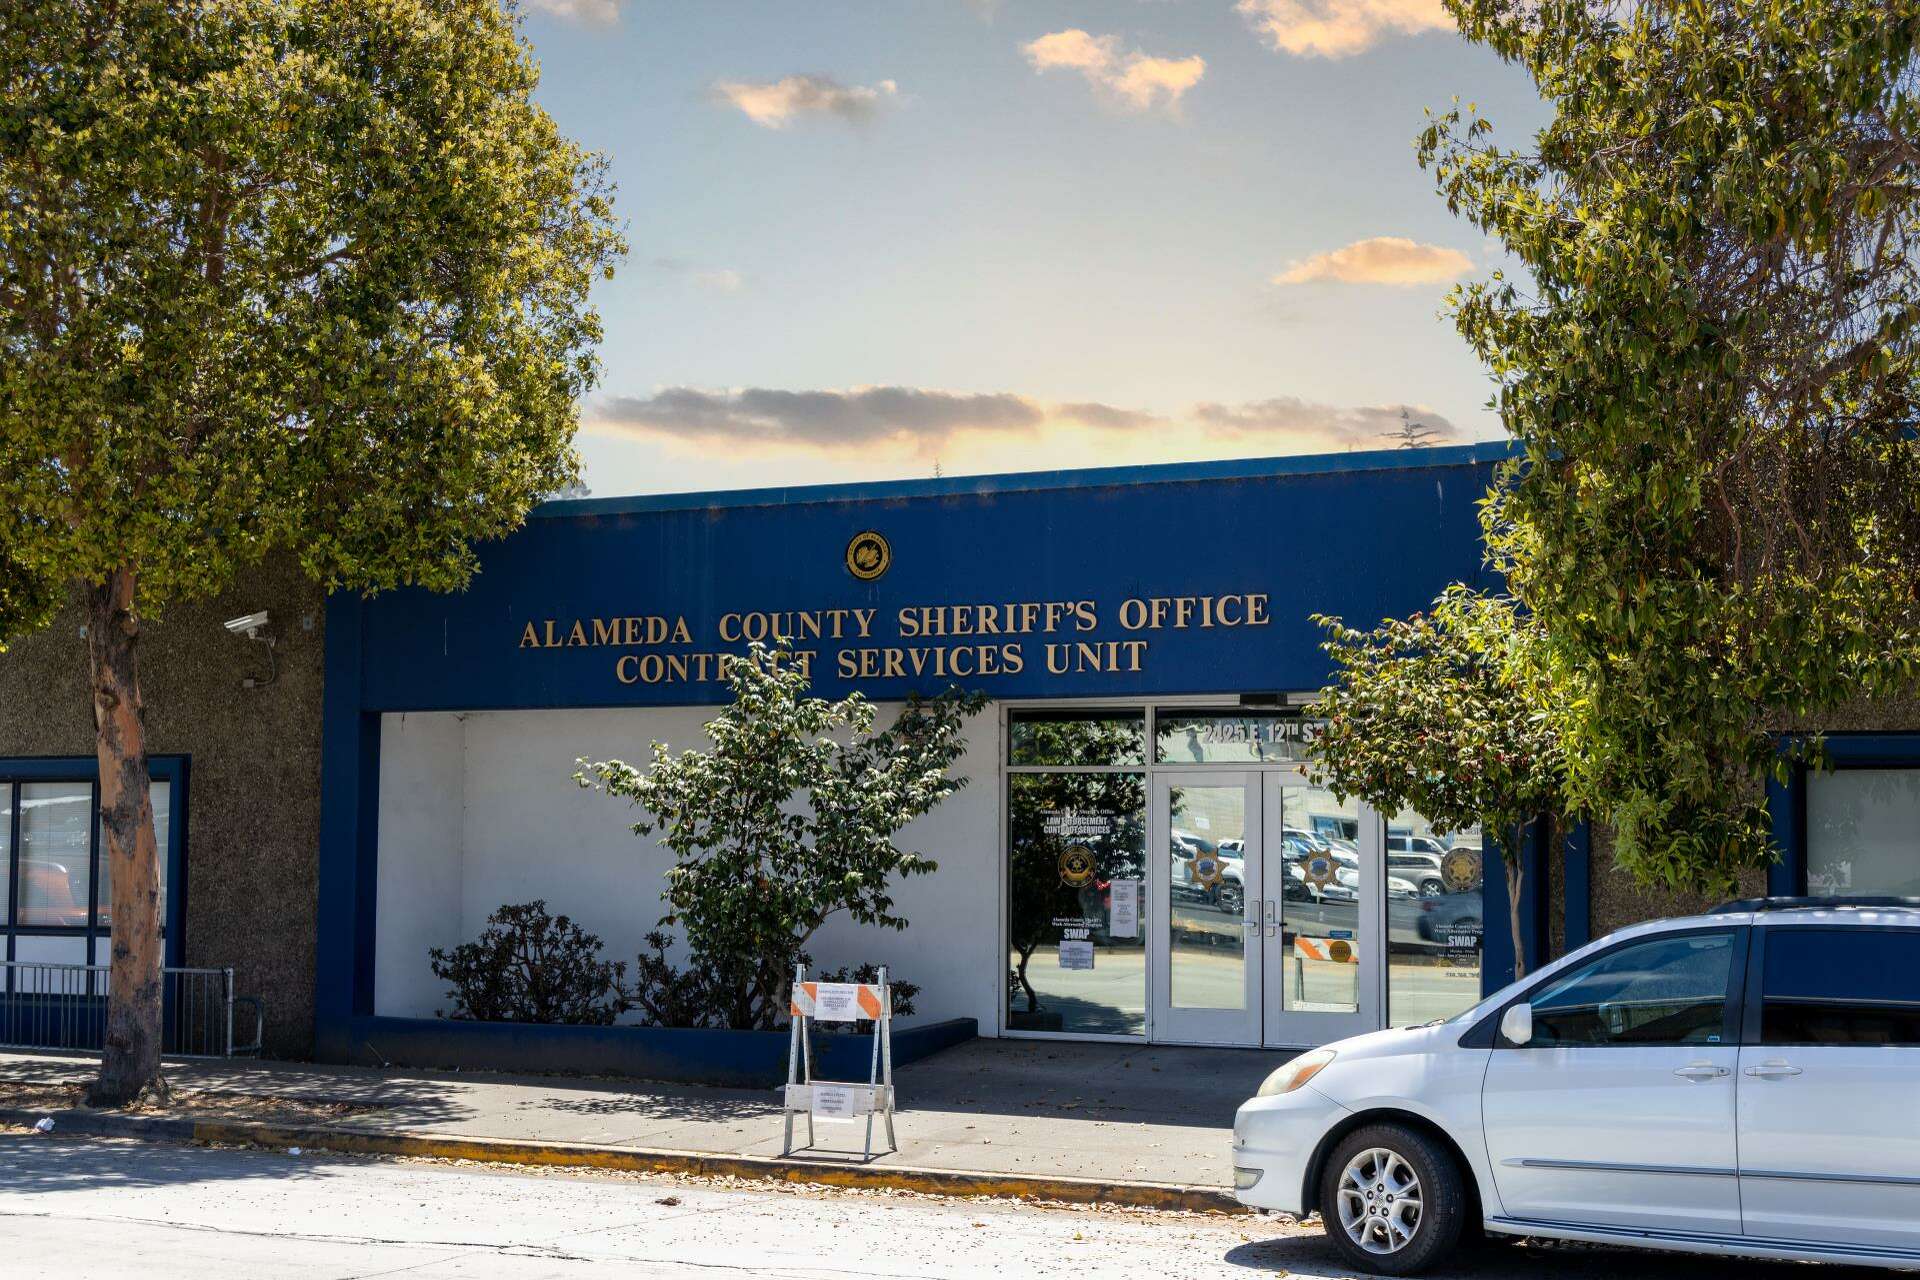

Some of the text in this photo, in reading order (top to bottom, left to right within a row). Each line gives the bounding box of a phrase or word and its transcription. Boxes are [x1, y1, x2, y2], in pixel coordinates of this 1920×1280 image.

[519, 593, 1270, 649] ALAMEDA COUNTY SHERIFF'S OFFICE
[838, 643, 1023, 679] SERVICES
[1044, 640, 1147, 674] UNIT
[1202, 724, 1246, 744] 2425
[1046, 816, 1061, 825] LAW
[1063, 928, 1090, 939] SWAP
[1447, 935, 1477, 947] SWAP
